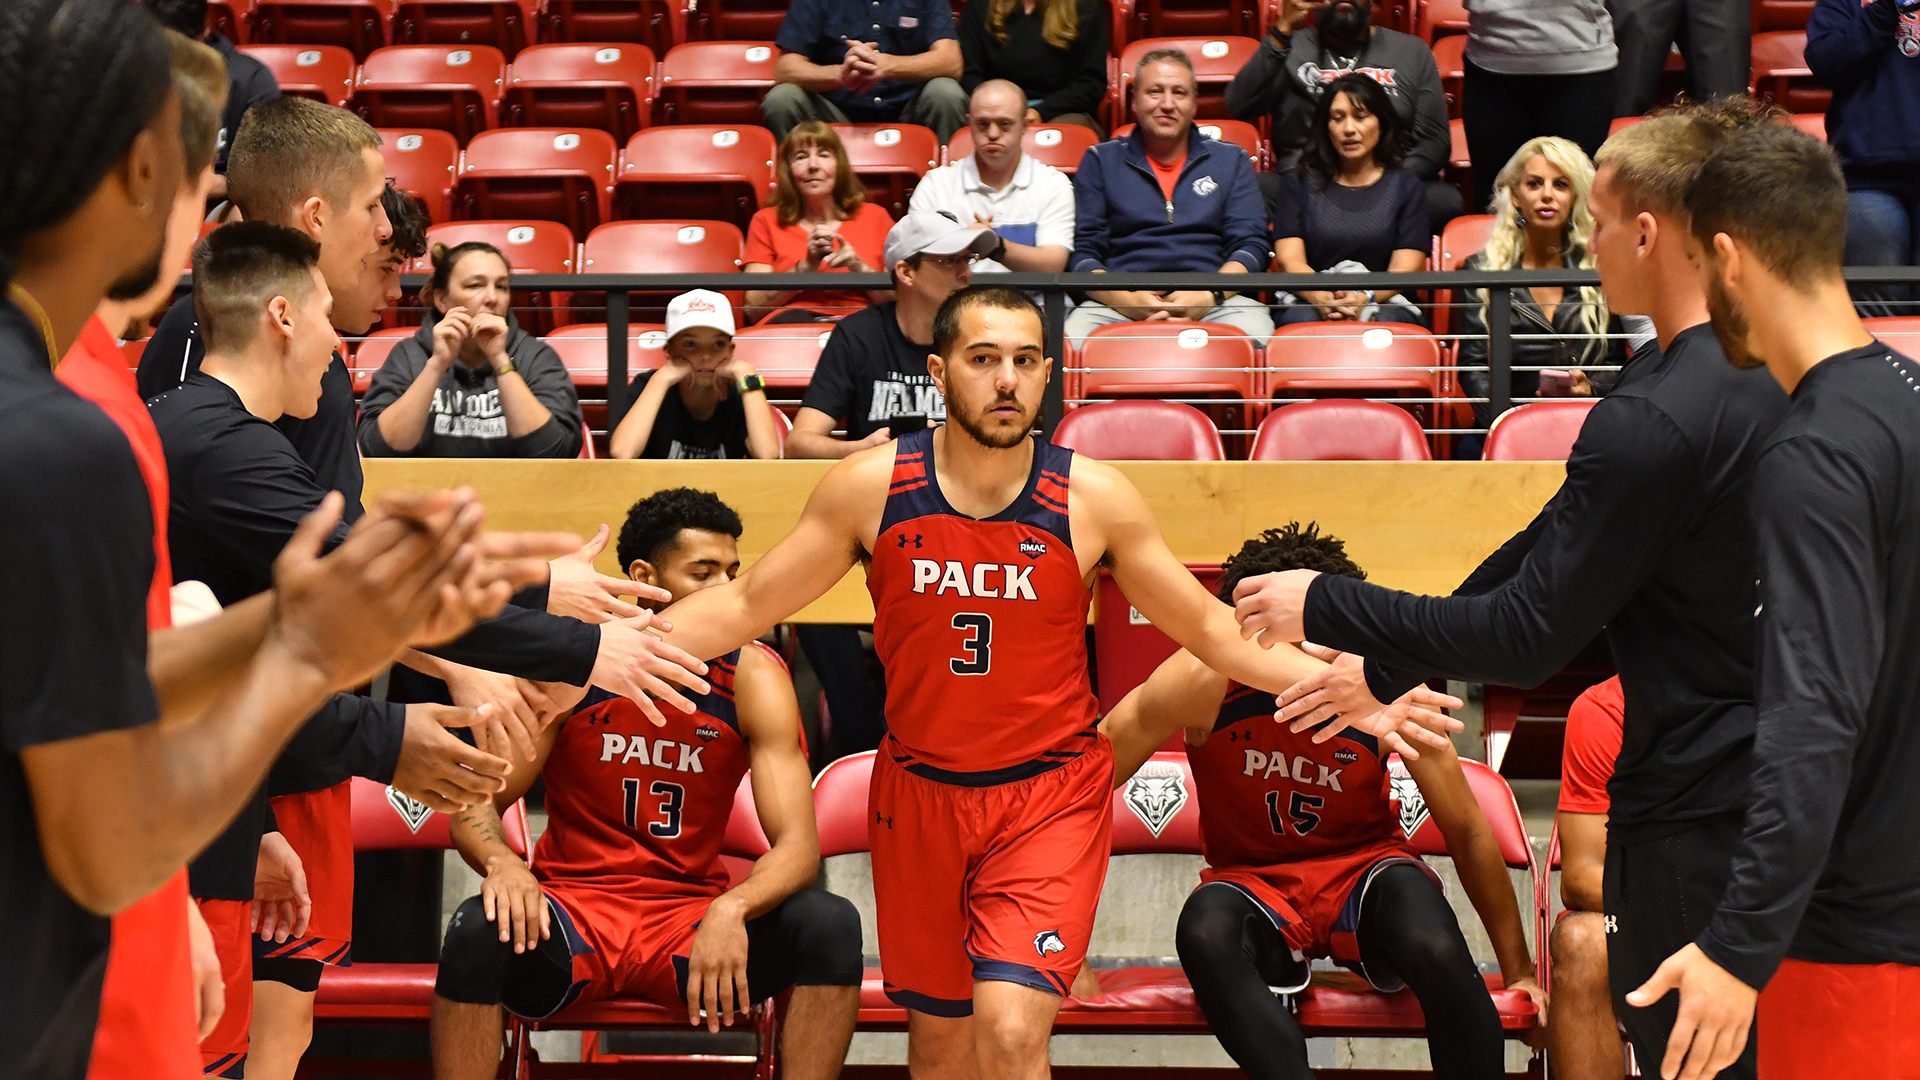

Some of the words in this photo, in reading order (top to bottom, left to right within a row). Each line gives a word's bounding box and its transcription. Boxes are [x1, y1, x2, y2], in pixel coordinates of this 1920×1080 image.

[430, 387, 463, 414] AN
[466, 388, 502, 418] DIE
[1020, 543, 1046, 553] RMAC
[911, 558, 1039, 601] PACK
[950, 612, 993, 676] 3
[599, 732, 705, 774] PACK
[695, 728, 720, 738] RMAC
[1242, 748, 1344, 793] PACK
[1334, 752, 1358, 761] RMAC
[622, 777, 685, 839] 13
[1265, 790, 1324, 836] 15
